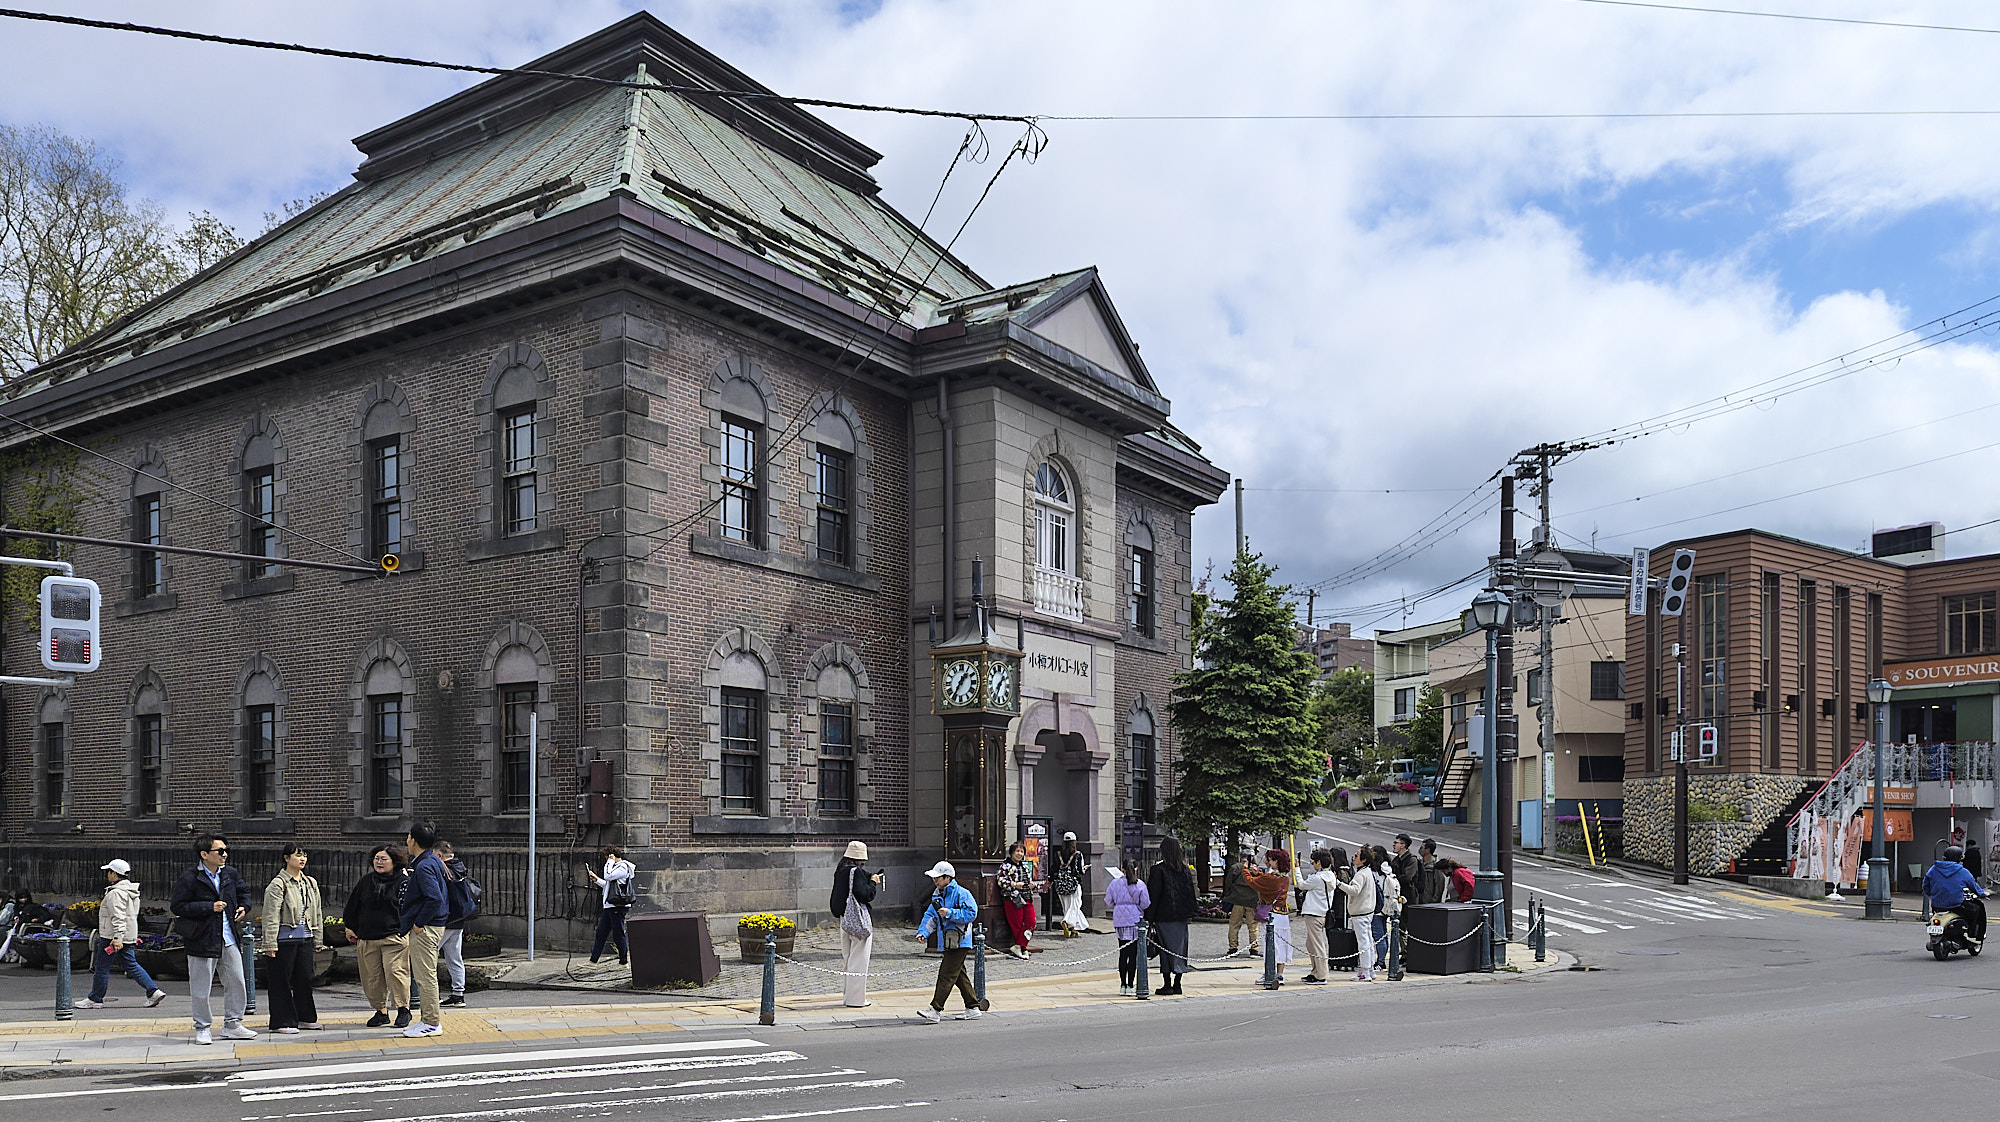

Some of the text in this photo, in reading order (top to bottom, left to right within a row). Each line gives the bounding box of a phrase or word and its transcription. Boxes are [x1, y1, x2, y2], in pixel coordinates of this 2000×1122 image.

[1635, 551, 1645, 611] 歩車分離式信号
[1028, 652, 1089, 678] 小樽オルゴール堂
[1905, 661, 2000, 680] SOUVENIR
[1901, 791, 1915, 800] SHOP
